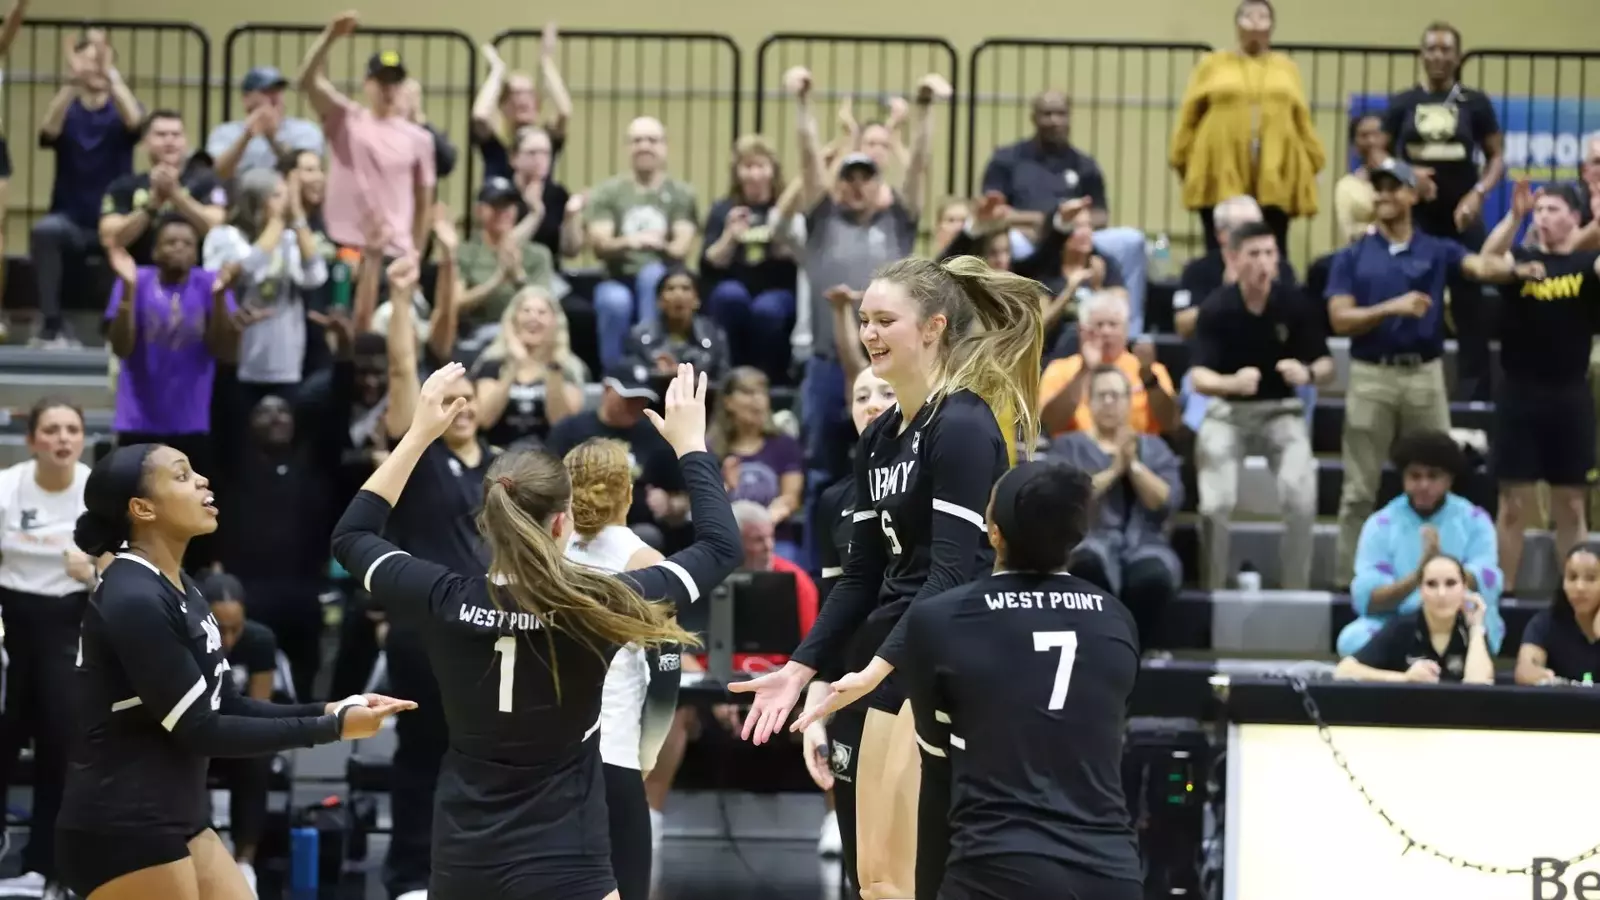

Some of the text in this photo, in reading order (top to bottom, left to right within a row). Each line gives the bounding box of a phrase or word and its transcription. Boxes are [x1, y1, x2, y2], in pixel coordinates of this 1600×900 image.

[1520, 271, 1583, 301] ARMY
[881, 510, 902, 554] 6
[459, 603, 508, 628] WEST
[984, 591, 1103, 611] WEST POINT
[494, 636, 516, 713] 1
[1032, 630, 1078, 711] 7
[1532, 857, 1600, 900] Be
